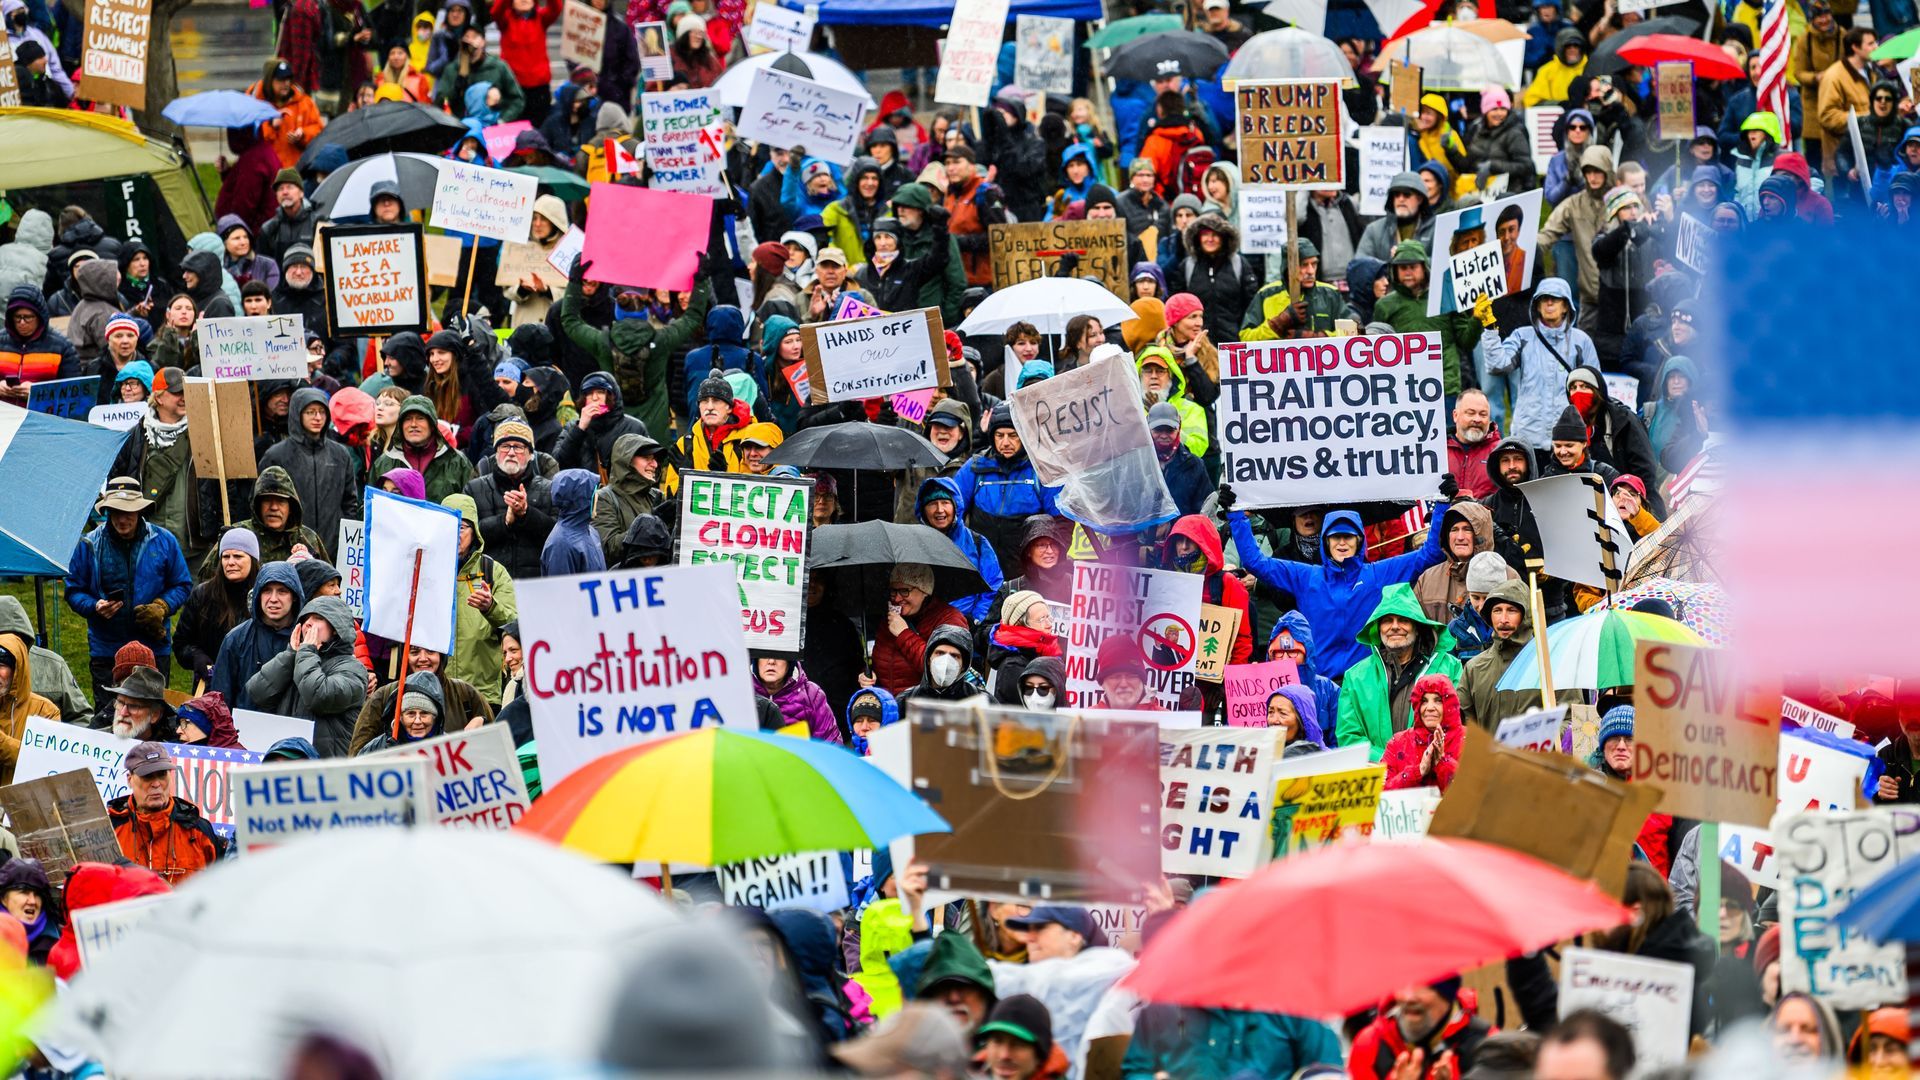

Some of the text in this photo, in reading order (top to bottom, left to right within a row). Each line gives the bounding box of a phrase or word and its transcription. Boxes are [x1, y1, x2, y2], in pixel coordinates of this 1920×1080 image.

[90, 5, 150, 36] RESPECT
[88, 30, 146, 59] WOMENS
[673, 96, 711, 112] POWER
[1239, 84, 1329, 110] TRUMP
[663, 114, 714, 131] PEOPLE
[1244, 113, 1329, 135] BREEDS
[1263, 139, 1318, 162] NAZI
[471, 170, 485, 184] the
[655, 167, 706, 184] POWER!
[1250, 162, 1328, 183] SCUM
[442, 184, 460, 195] are
[473, 208, 496, 221] States
[350, 258, 391, 274] IS A
[1453, 249, 1500, 280] Listen
[338, 271, 402, 290] FASCIST
[1463, 279, 1472, 287] to
[341, 286, 414, 309] VOCABULARY
[353, 307, 395, 326] WORD
[205, 322, 254, 340] This is
[823, 319, 913, 350] HANDS OFF
[205, 344, 213, 358] A
[219, 341, 258, 357] MORAL
[860, 345, 900, 364] our
[1218, 333, 1443, 377] Trump GOP=
[215, 364, 253, 379] RIGHT
[36, 383, 91, 403] HANDS
[1220, 373, 1443, 412] TRAITOR to
[103, 410, 140, 422] HANDS
[1225, 409, 1440, 444] democracy,
[1225, 443, 1440, 483] laws & truth
[690, 480, 807, 524] ELECT A
[698, 520, 804, 554] CLOWN
[578, 575, 665, 618] THE
[528, 631, 728, 701] Constitution
[1226, 678, 1265, 699] HANDS
[616, 704, 676, 734] NOT
[690, 697, 725, 730] A
[1810, 710, 1840, 734] Your
[1684, 722, 1727, 748] OUR
[24, 727, 125, 768] DEMOCRACY
[96, 765, 119, 780] IN
[244, 768, 414, 806] HELL NO!
[435, 768, 517, 813] NEVER
[1313, 775, 1381, 801] SUPPORT
[1239, 790, 1260, 821] A
[247, 814, 285, 834] Not
[292, 812, 324, 833] My
